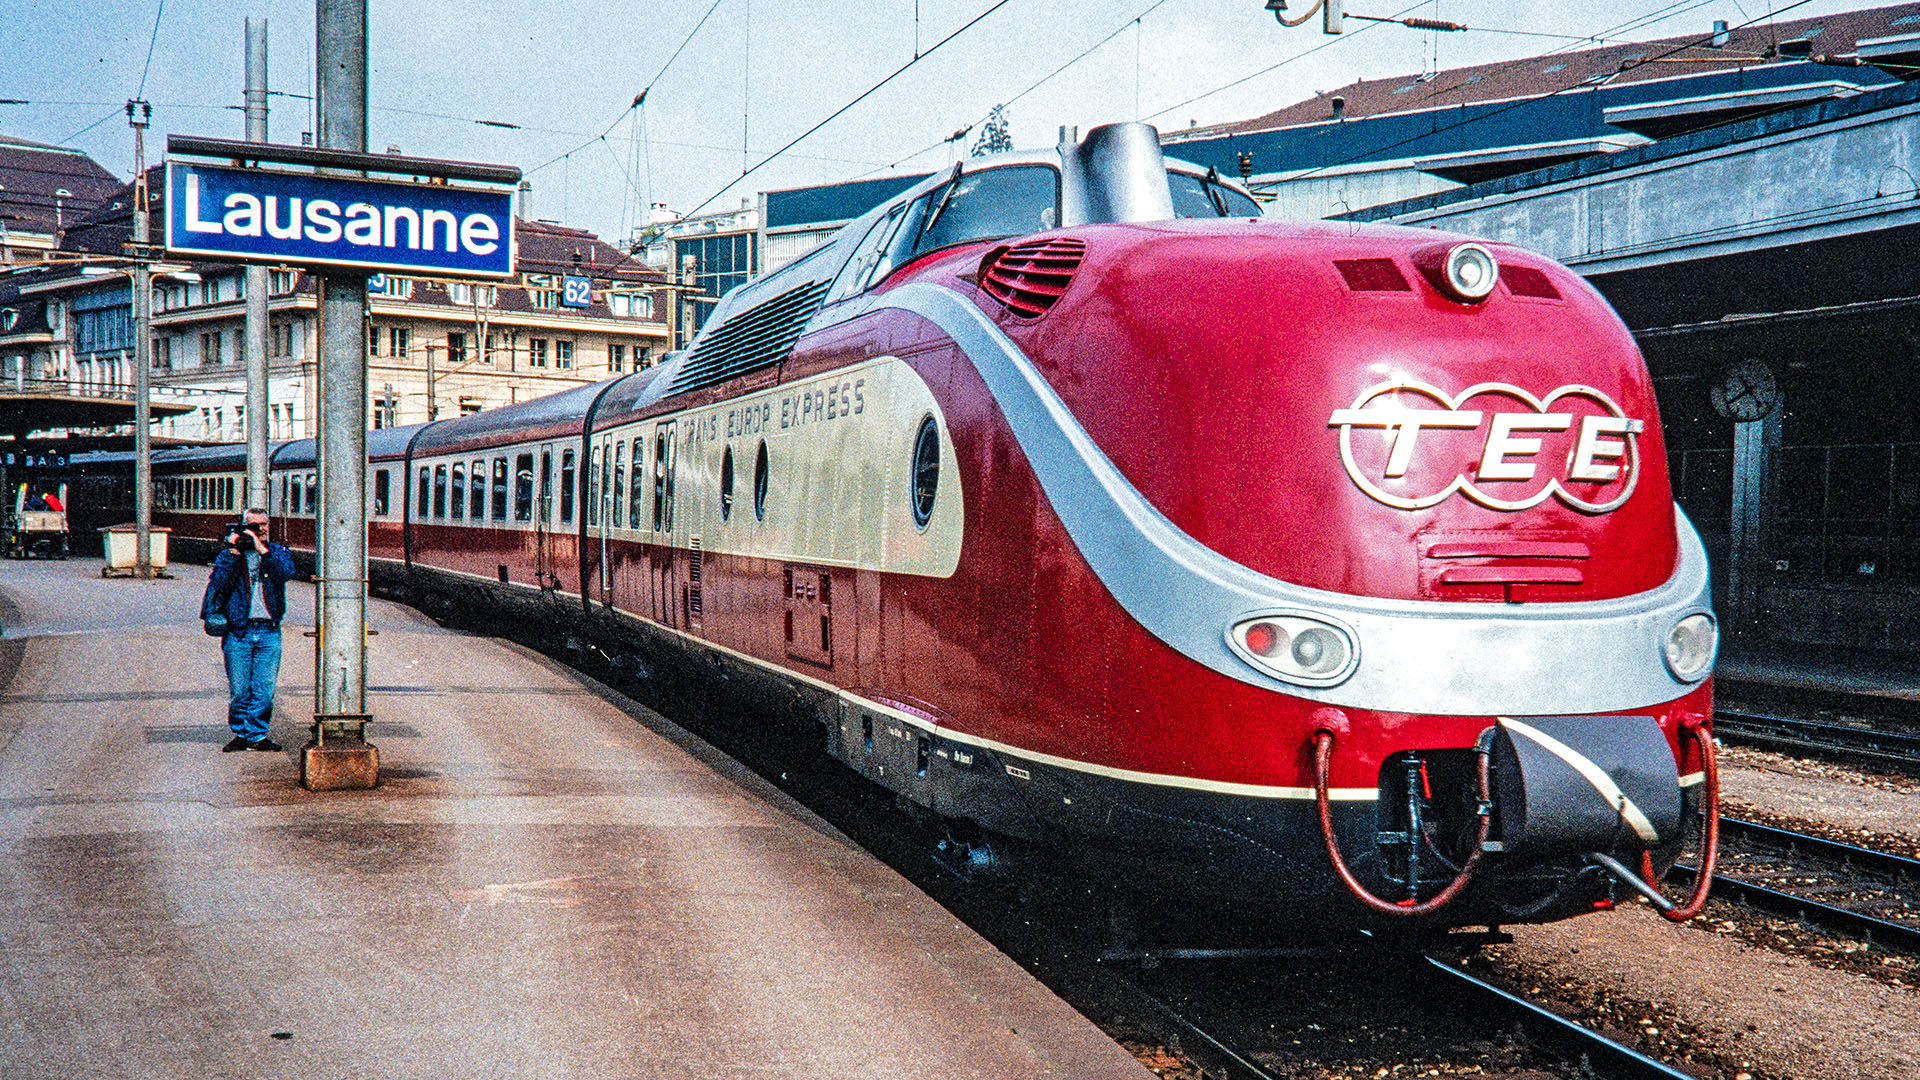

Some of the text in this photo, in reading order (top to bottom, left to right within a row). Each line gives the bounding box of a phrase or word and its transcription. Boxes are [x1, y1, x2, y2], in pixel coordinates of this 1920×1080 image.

[185, 173, 500, 256] Lausanne
[565, 280, 590, 304] 62
[727, 402, 770, 438] EUROP
[781, 378, 866, 430] EXPRESS
[1327, 407, 1644, 483] TEE
